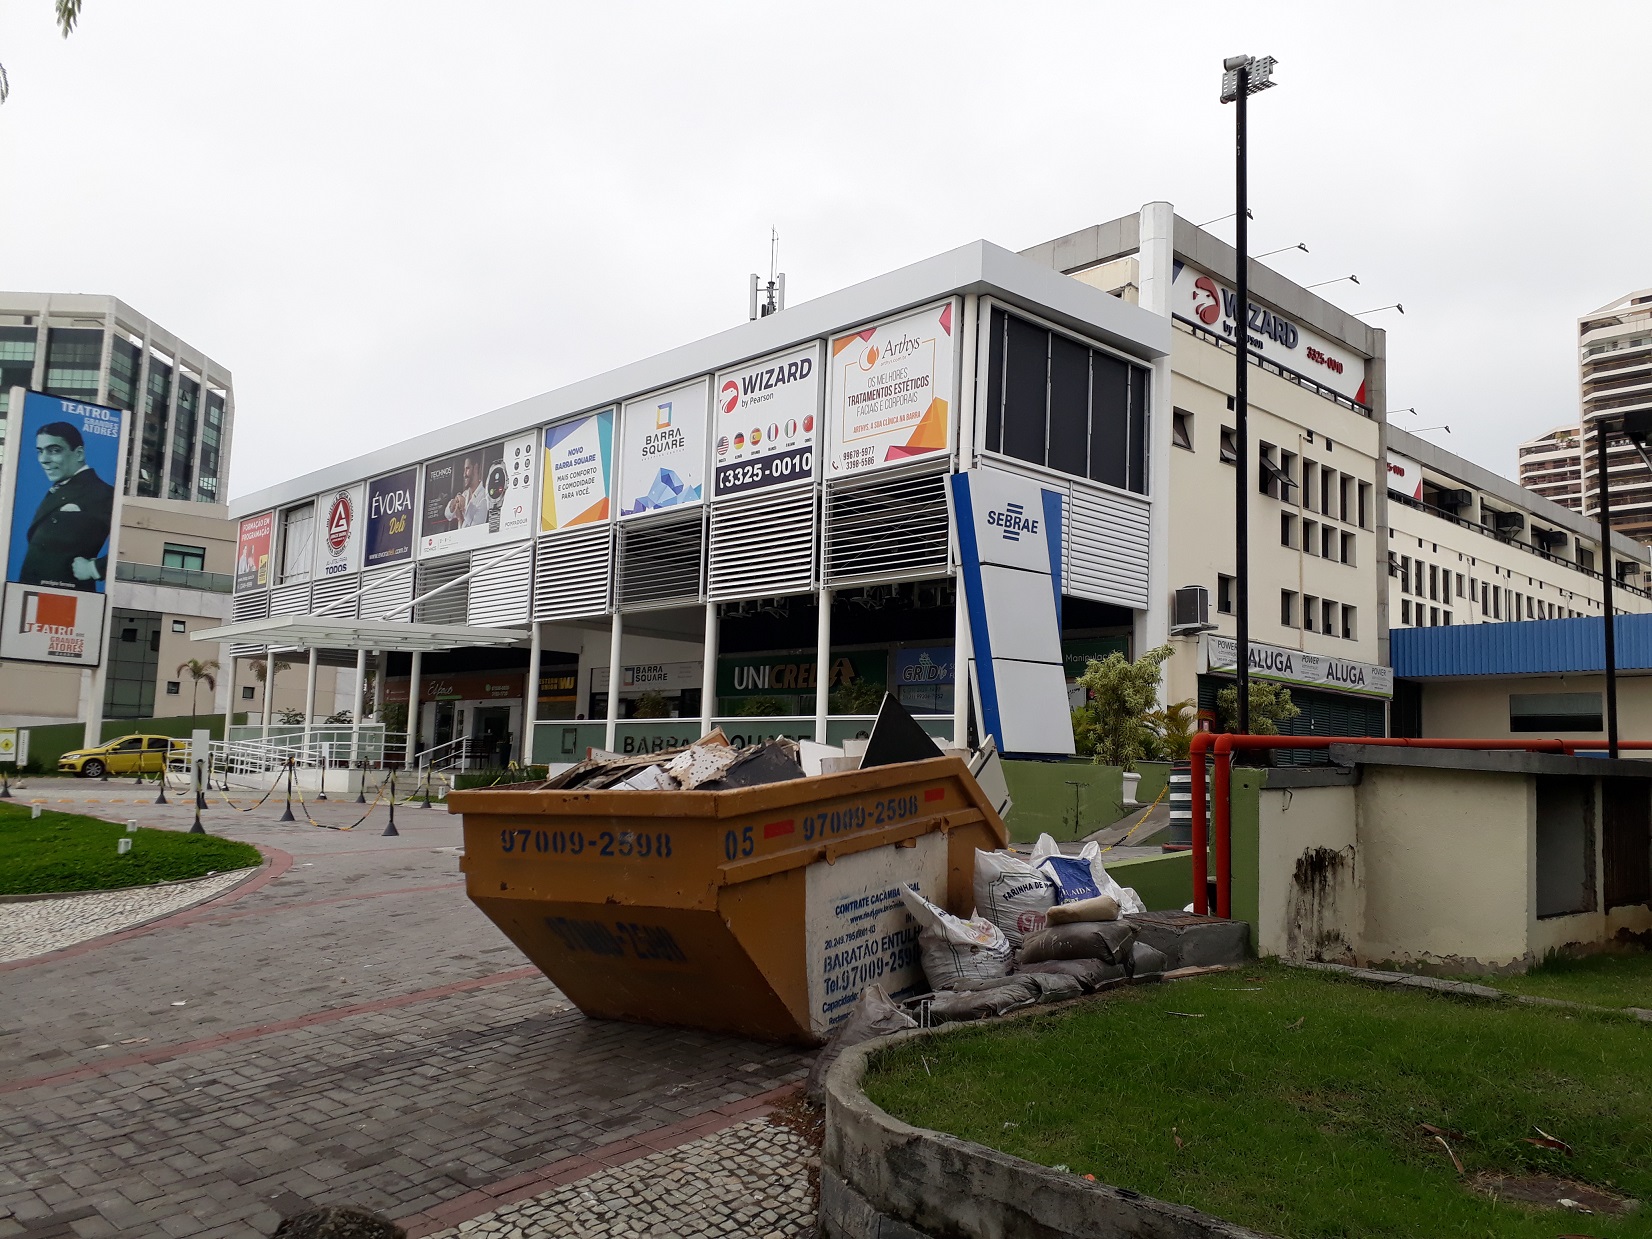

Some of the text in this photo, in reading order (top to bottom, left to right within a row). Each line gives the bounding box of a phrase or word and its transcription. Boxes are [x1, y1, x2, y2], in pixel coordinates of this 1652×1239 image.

[1222, 287, 1299, 349] WZARD
[1223, 320, 1233, 336] by
[882, 334, 921, 359] Arthys
[1306, 346, 1343, 374] 3325-0010
[741, 358, 812, 396] WIZARD
[867, 366, 908, 389] OS MELHORES
[741, 392, 774, 408] by Pearson
[847, 374, 930, 407] TRATAMENTOS ESTÉTICOS
[61, 400, 110, 421] TEATRO
[856, 401, 879, 418] FACIAIS
[884, 391, 918, 410] CORPORAIS
[874, 420, 883, 429] SUA
[899, 414, 906, 423] NA
[905, 410, 921, 422] BARRA
[82, 424, 119, 438] ATORES
[645, 427, 682, 446] BARRA
[567, 445, 584, 457] NOVO
[641, 436, 685, 457] SQUARE
[554, 453, 597, 471] BARRA SQUARE
[556, 466, 598, 483] MAIS CONFORTO
[557, 476, 595, 492] E COMODIDADE
[371, 489, 412, 519] ÉVORA
[561, 490, 575, 501] PARA
[242, 517, 271, 531] FORMAÇÃO EM
[987, 510, 1039, 535] SEBRAE
[241, 527, 270, 541] PROGRAMAÇÃO
[325, 563, 348, 575] TODOS
[26, 622, 75, 636] TEATRO
[48, 643, 84, 653] ATORES
[50, 636, 84, 645] GRANDES
[635, 665, 663, 675] BARRA
[1248, 648, 1294, 674] ALUGA
[1301, 655, 1320, 665] POWER
[1326, 662, 1366, 686] ALUGA
[635, 673, 668, 683] SQUARE
[1371, 667, 1387, 677] POWER
[558, 676, 576, 690] WU
[803, 795, 919, 841] 97009-2598
[501, 829, 673, 858] 97009-2598
[724, 826, 754, 861] 05
[1002, 883, 1034, 902] FARINHA
[1034, 881, 1044, 890] DE
[835, 896, 870, 916] CONTRATE
[881, 925, 922, 952] ENTULH
[823, 939, 879, 973] BARATÃO
